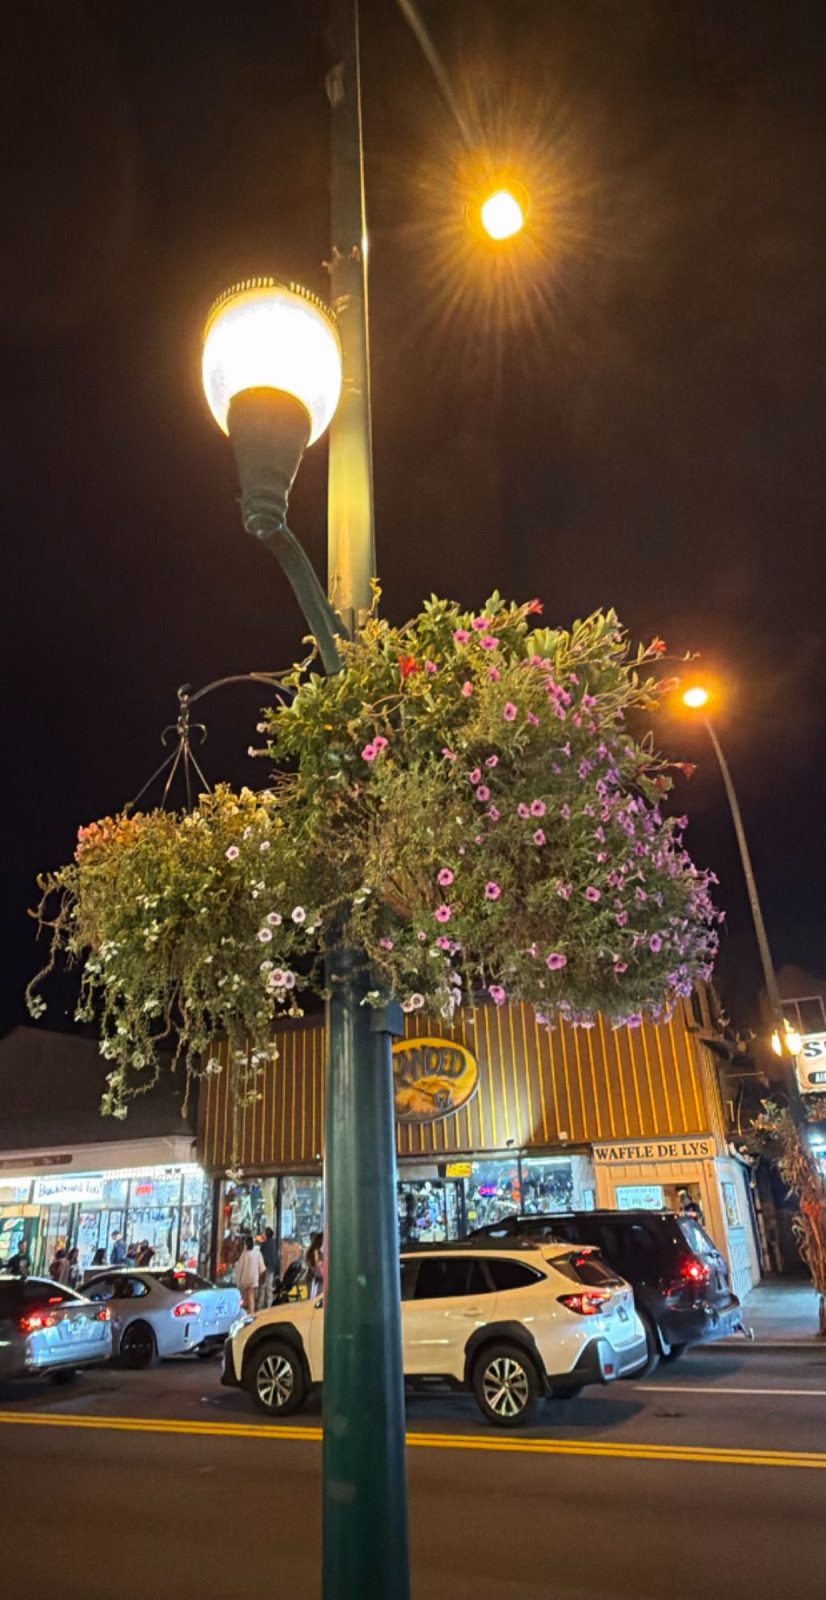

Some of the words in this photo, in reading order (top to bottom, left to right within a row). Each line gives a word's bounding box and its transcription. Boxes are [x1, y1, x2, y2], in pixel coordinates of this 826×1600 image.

[803, 1040, 826, 1057] S
[595, 1145, 654, 1161] WAFFLE
[657, 1143, 678, 1159] DE
[681, 1142, 709, 1157] LYS
